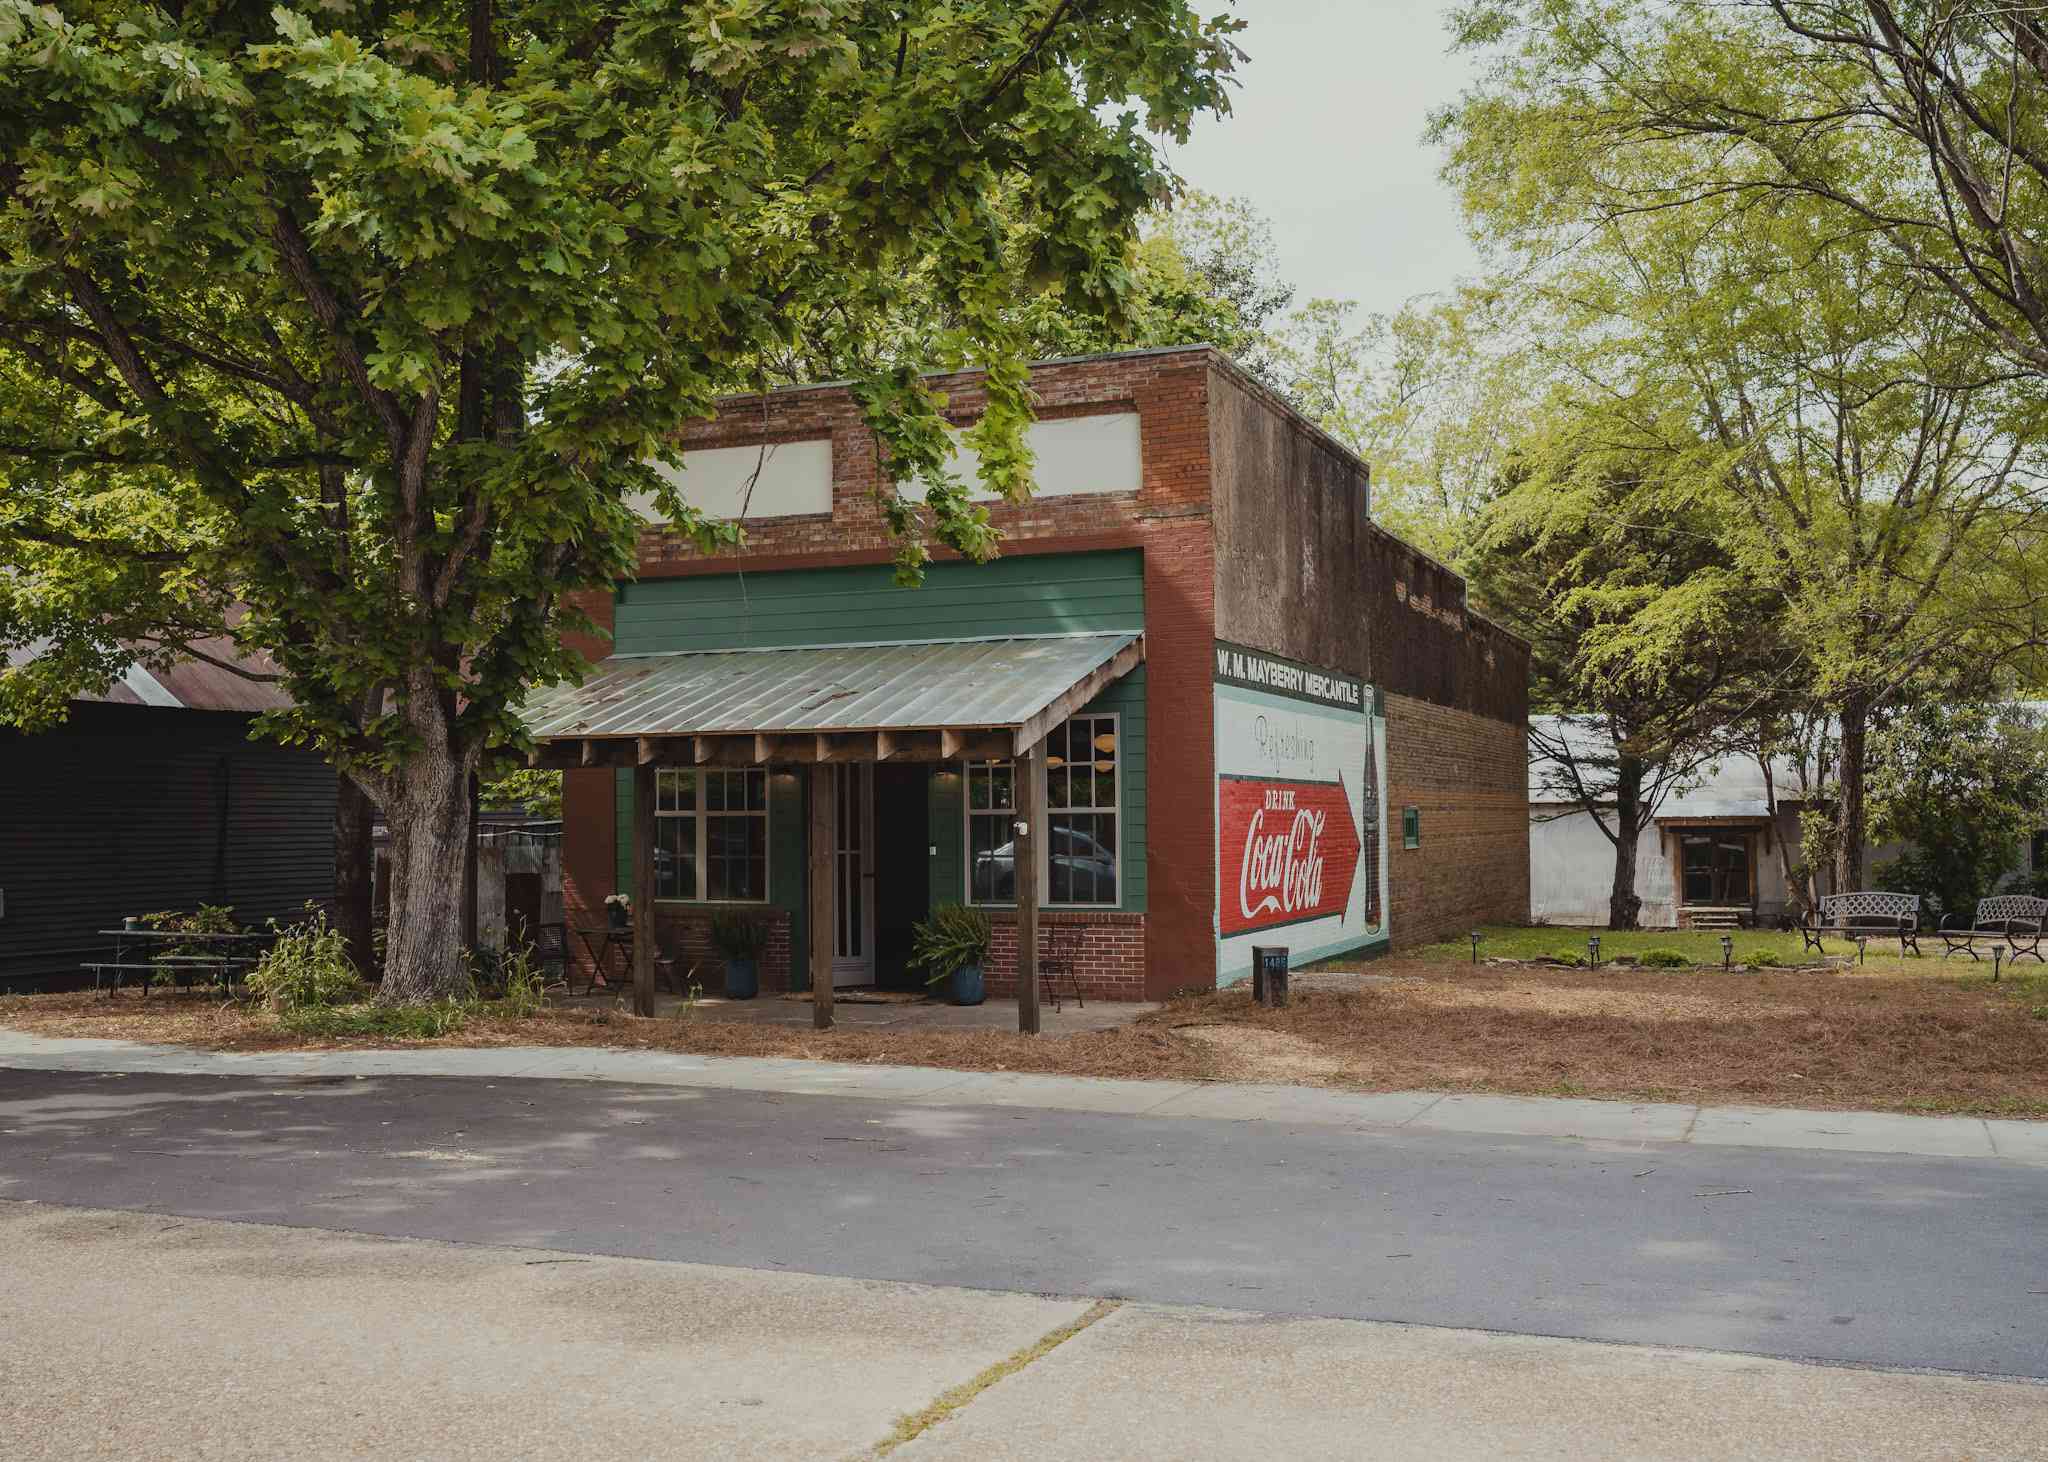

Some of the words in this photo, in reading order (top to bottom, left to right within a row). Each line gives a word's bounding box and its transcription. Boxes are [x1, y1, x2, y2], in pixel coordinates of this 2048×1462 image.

[1217, 648, 1232, 676] W.
[1233, 653, 1246, 680] M.
[1247, 656, 1304, 692] MAYBERRY
[1304, 671, 1360, 704] MERCANTILE
[1265, 789, 1297, 810] DRINK
